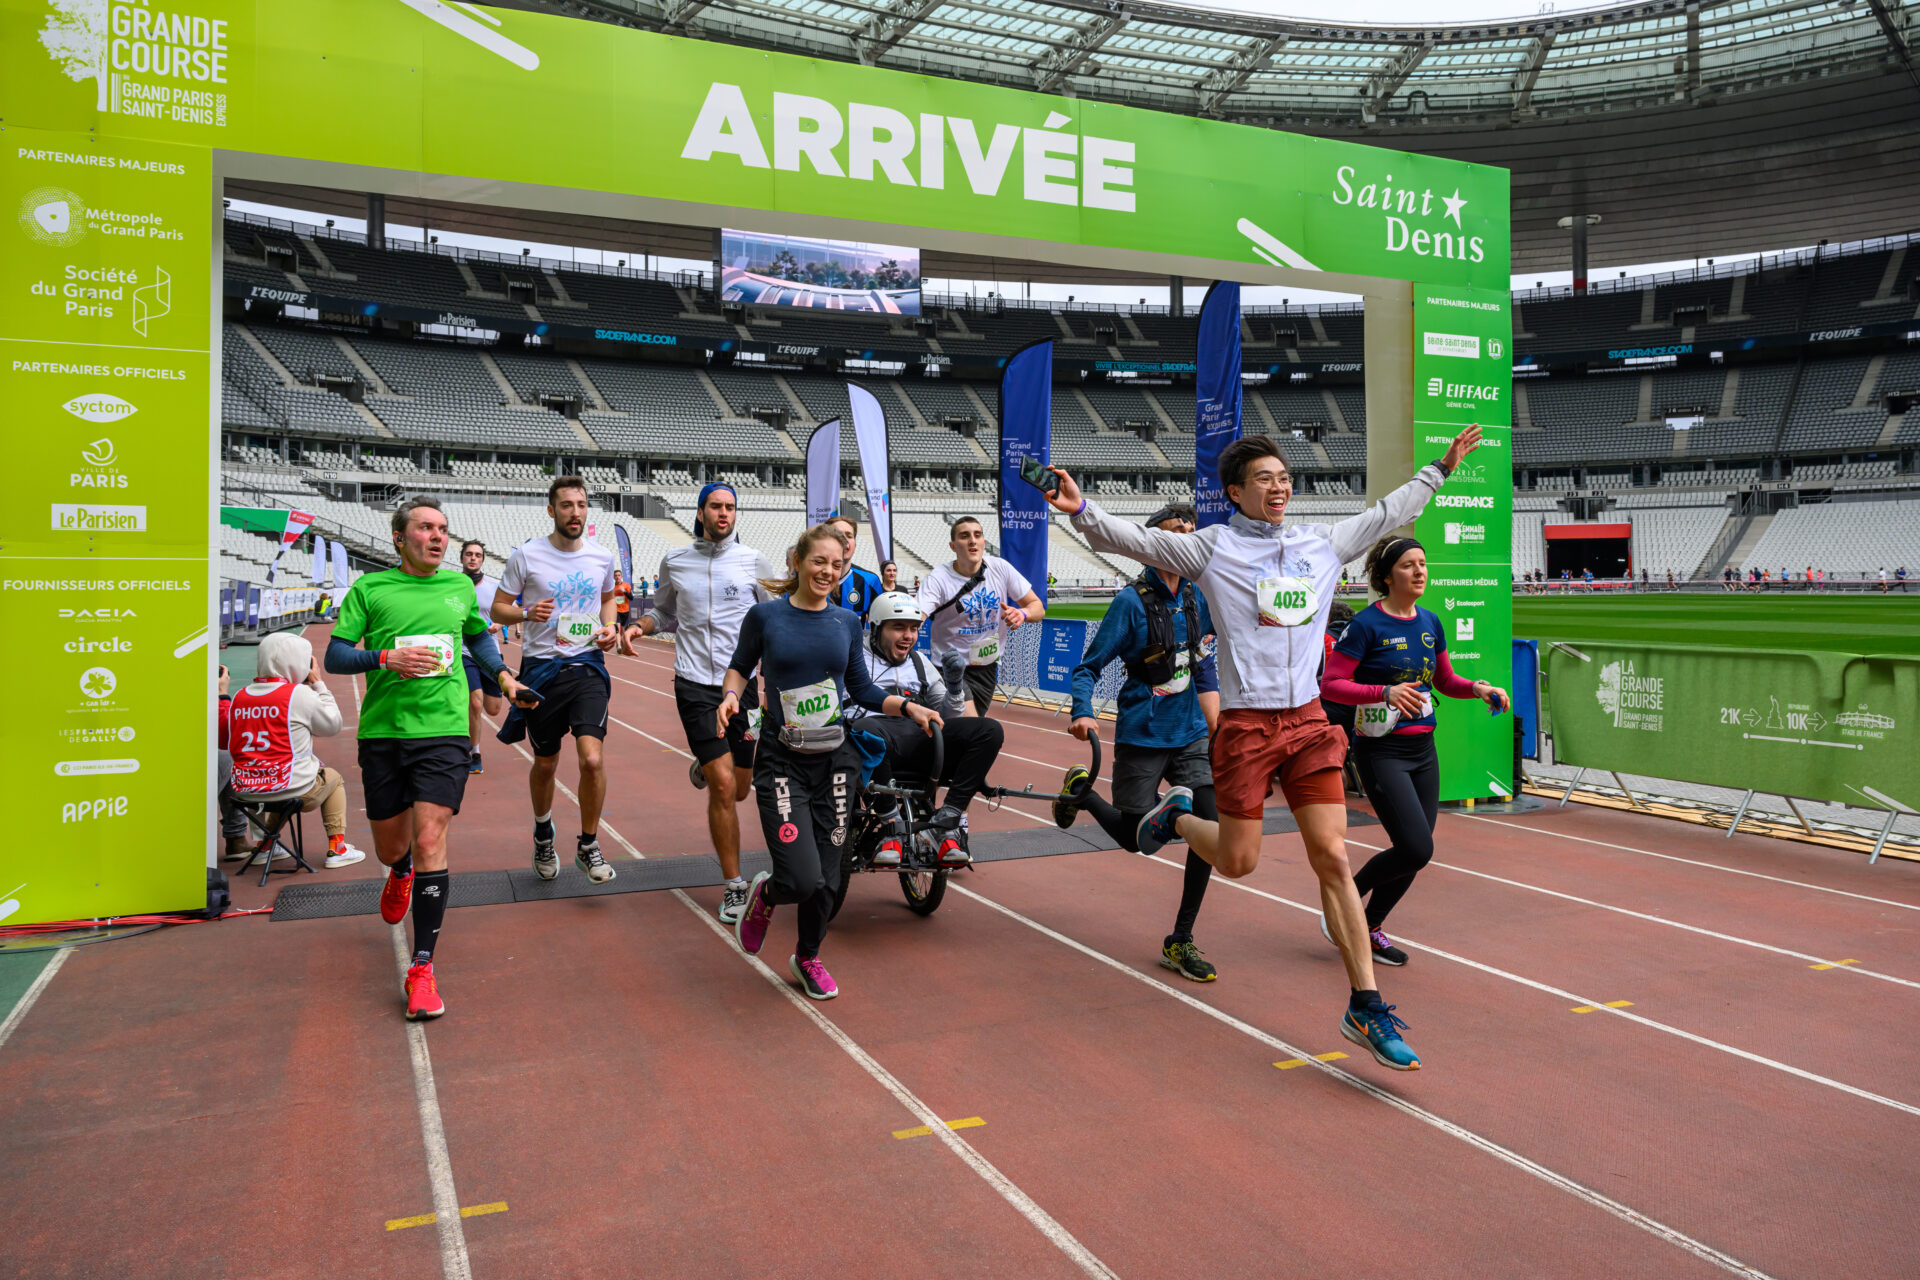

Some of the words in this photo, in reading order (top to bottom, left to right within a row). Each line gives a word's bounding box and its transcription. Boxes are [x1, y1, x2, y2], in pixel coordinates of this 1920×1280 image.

[112, 6, 228, 51] GRANDE
[112, 38, 228, 84] COURSE
[123, 82, 170, 103] GRAND
[173, 89, 213, 108] PARIS
[122, 99, 213, 125] SAINT-DENIS
[216, 94, 226, 127] EXPRESS
[680, 82, 1136, 213] ARRIVÉE
[18, 148, 116, 168] PARTENAIRES
[119, 158, 186, 175] MAJEURS
[1333, 166, 1434, 216] Saint
[85, 208, 163, 226] Métropole
[88, 221, 99, 229] du
[101, 223, 145, 237] Grand
[150, 228, 184, 241] Paris
[1385, 216, 1485, 263] Denis
[64, 265, 138, 284] Société
[31, 281, 56, 296] du
[63, 283, 123, 301] Grand
[65, 301, 114, 318] Paris
[1427, 297, 1470, 309] PARTENAIRES
[1471, 302, 1500, 312] MAJEURS
[12, 361, 110, 376] PARTENAIRES
[114, 366, 187, 380] OFFICIELS
[1446, 383, 1501, 401] EIFFAGE
[69, 400, 132, 415] syctom
[1005, 449, 1024, 457] Paris
[1009, 442, 1032, 450] Grand
[70, 473, 129, 489] PARIS
[1197, 477, 1208, 488] LE
[1197, 489, 1224, 500] NOUV
[1435, 495, 1495, 509] STADEFRANCE
[60, 512, 75, 528] Le
[77, 507, 137, 529] Parisien
[3, 579, 115, 591] FOURNISSEURS
[118, 580, 191, 591] OFFICIELS
[1430, 578, 1473, 586] PARTENAIRES
[1474, 577, 1498, 586] MÉDIAS
[1273, 590, 1307, 609] 4023
[58, 608, 137, 617] DACIA
[569, 623, 592, 636] 4361
[64, 636, 133, 653] circle
[978, 642, 998, 658] 4025
[1621, 659, 1635, 675] LA
[1621, 676, 1664, 693] GRANDE
[796, 693, 831, 717] 4022
[1620, 692, 1664, 710] COURSE
[235, 706, 279, 720] PHOTO
[1623, 712, 1641, 722] GRAND
[1642, 714, 1658, 723] PARIS
[1720, 707, 1741, 725] 21K
[1786, 712, 1808, 731] 10K
[241, 731, 271, 752] 25
